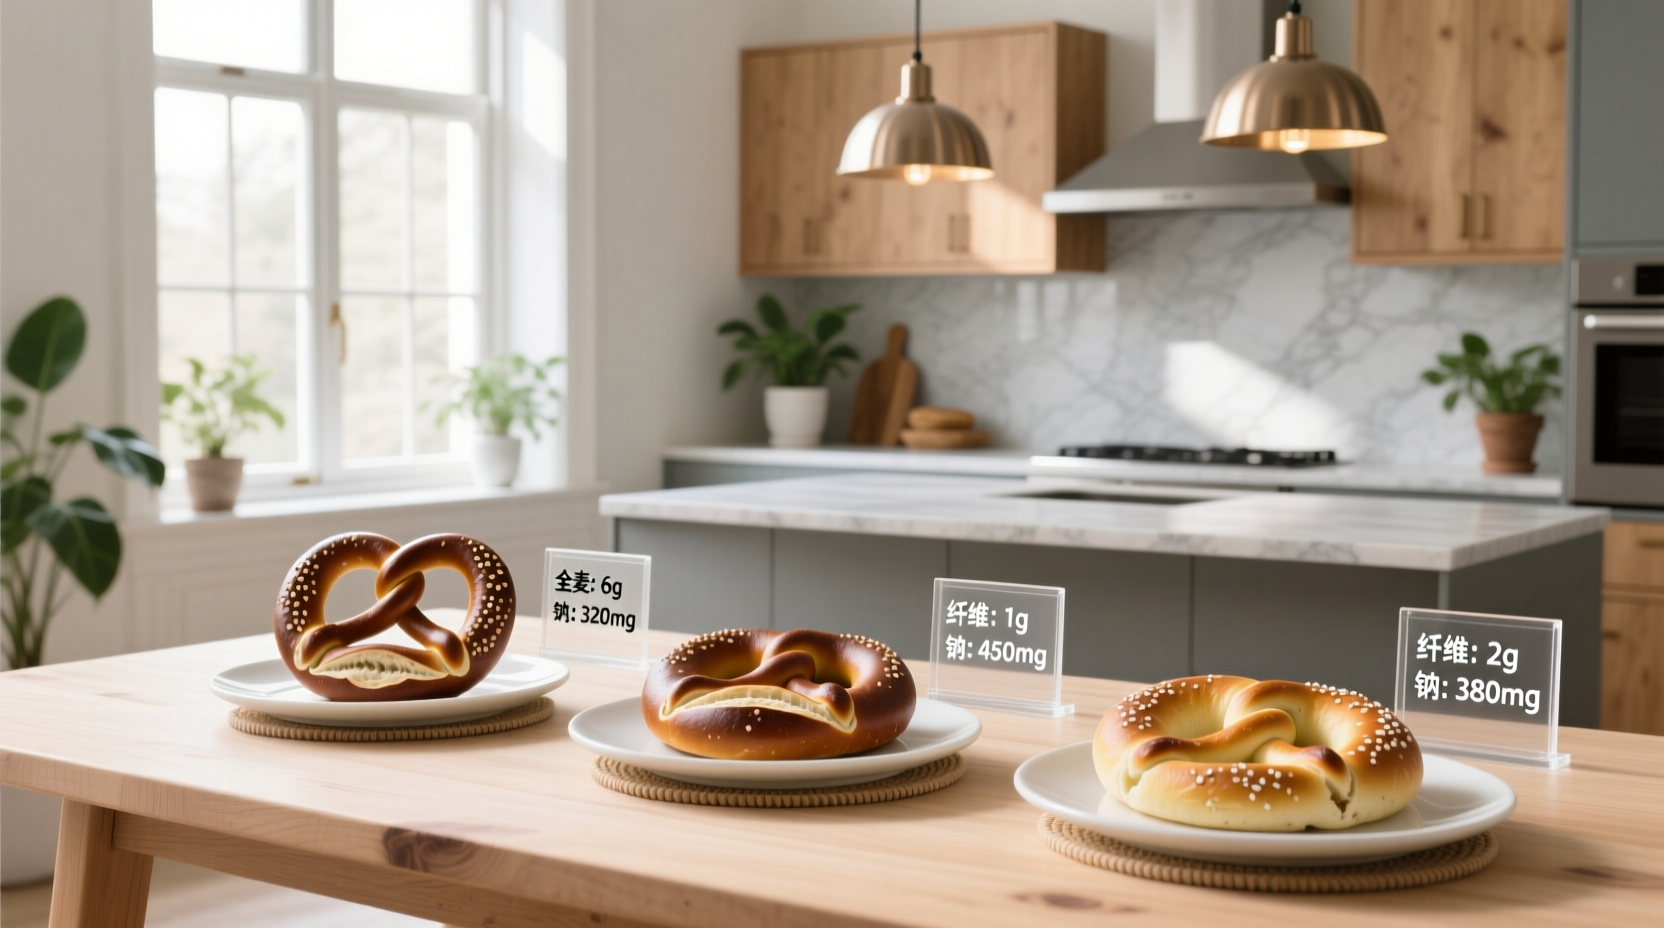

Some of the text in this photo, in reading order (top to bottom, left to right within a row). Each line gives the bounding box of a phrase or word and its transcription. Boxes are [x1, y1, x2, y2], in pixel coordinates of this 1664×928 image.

[601, 575, 623, 600] 6g
[580, 605, 636, 633] 320mg
[1005, 607, 1029, 635] 1g
[977, 639, 1047, 671] 450mg
[1486, 641, 1519, 674] 2g
[1455, 677, 1541, 715] 380mg
